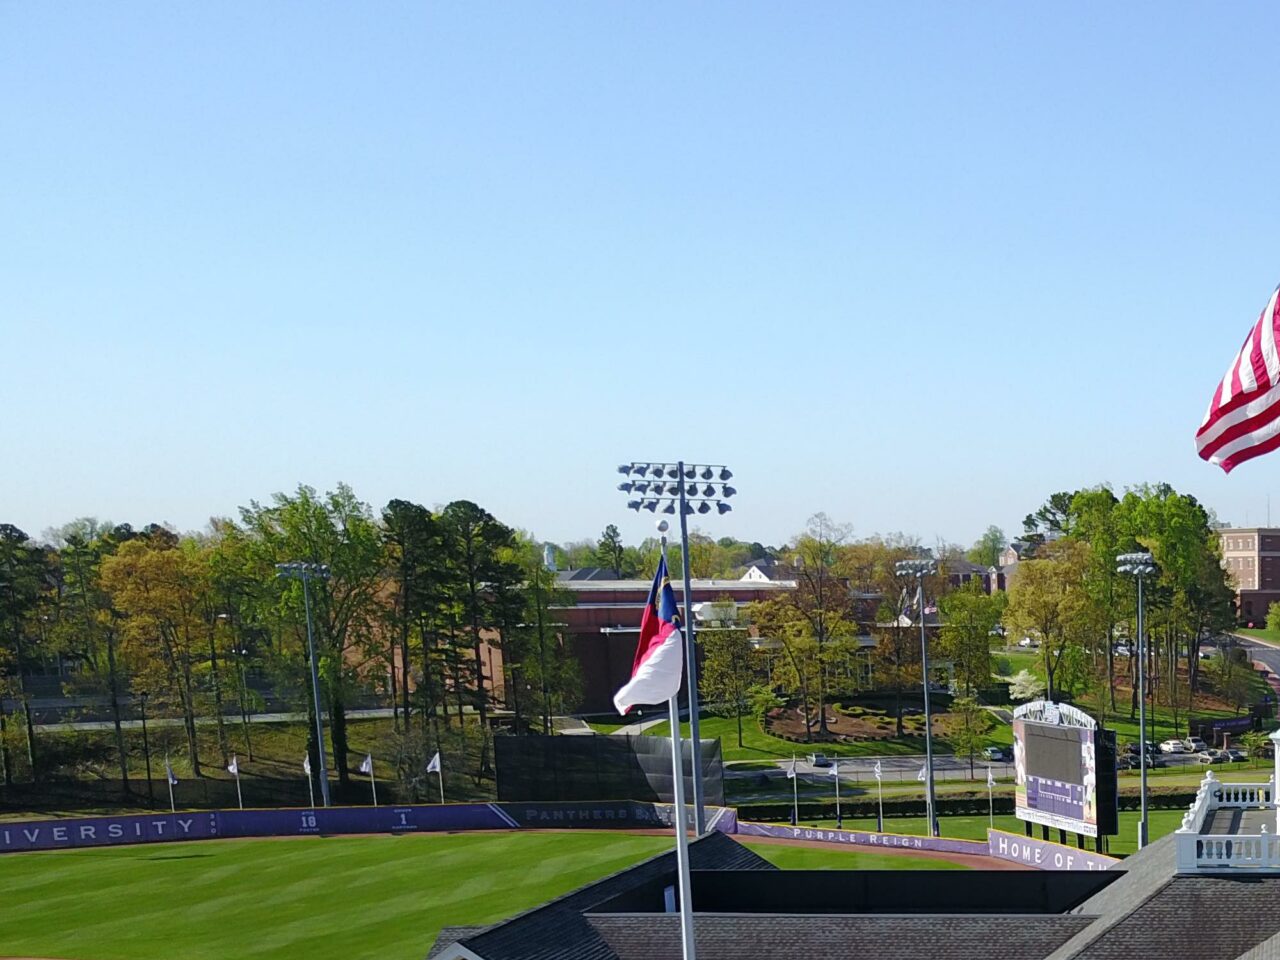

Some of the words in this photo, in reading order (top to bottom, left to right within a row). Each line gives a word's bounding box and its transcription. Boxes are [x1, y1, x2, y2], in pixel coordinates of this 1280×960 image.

[526, 809, 628, 821] PANTHERS
[793, 828, 856, 842] PURPLE
[869, 834, 922, 848] REIGN
[999, 837, 1041, 863] HOME
[1054, 853, 1074, 870] OF
